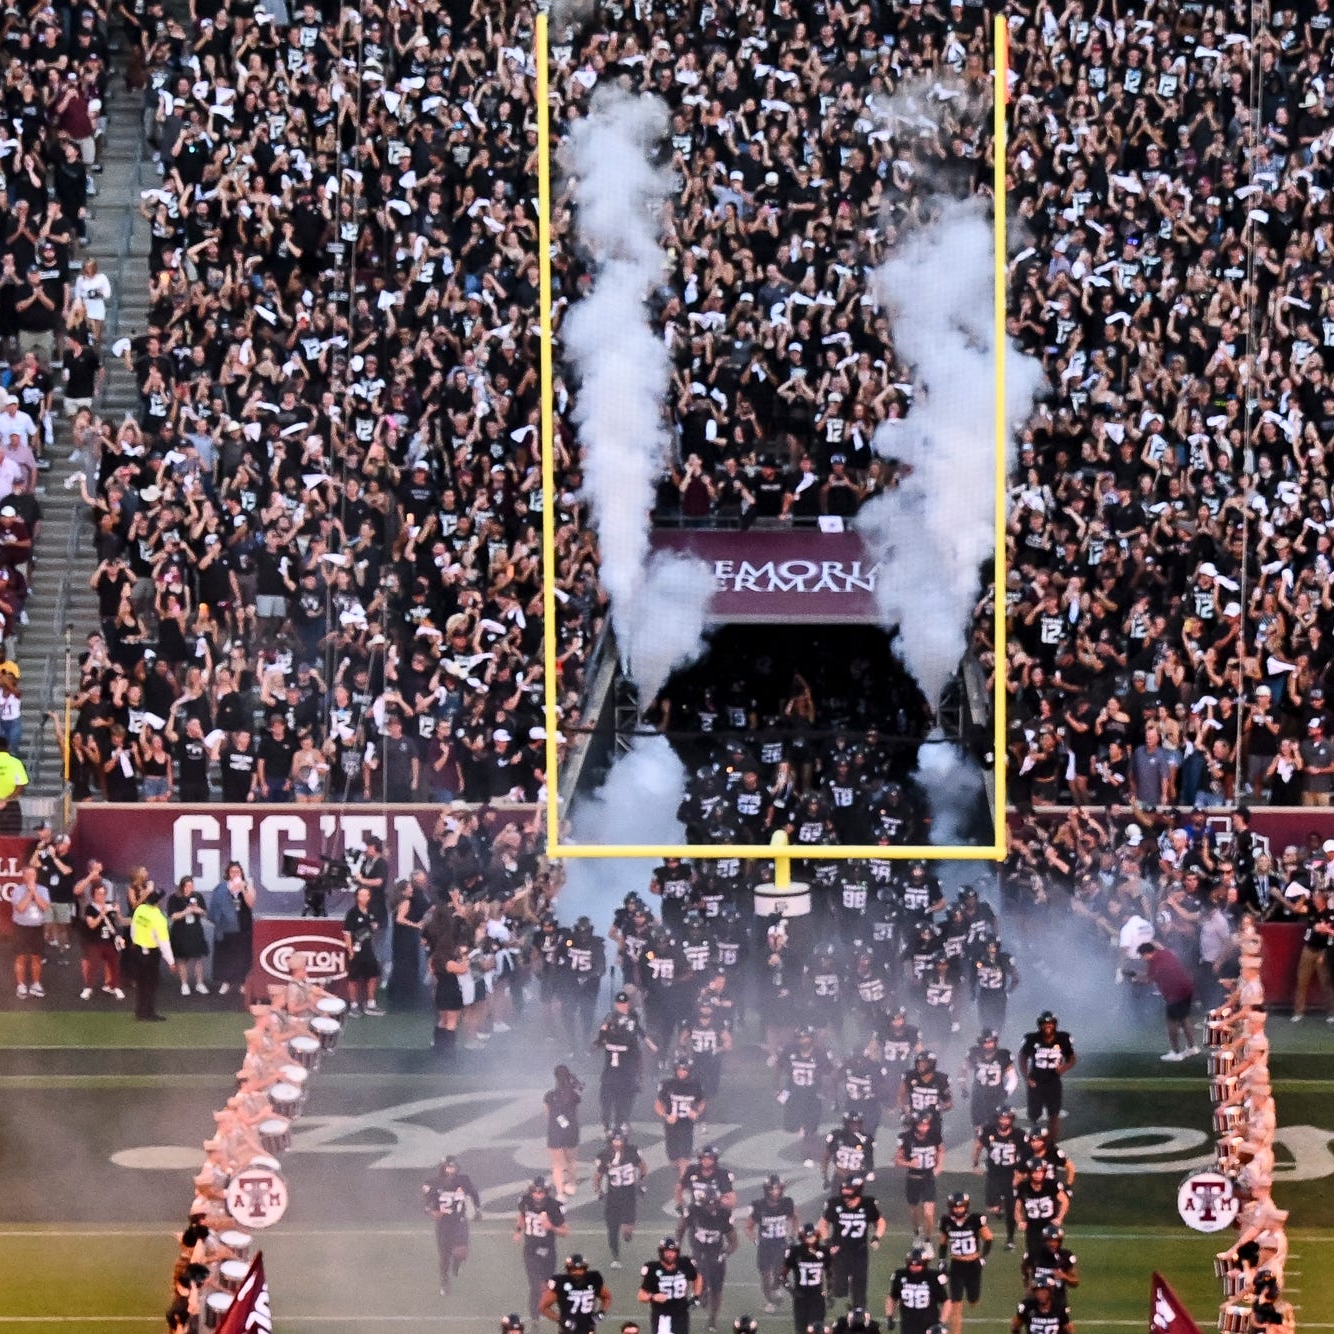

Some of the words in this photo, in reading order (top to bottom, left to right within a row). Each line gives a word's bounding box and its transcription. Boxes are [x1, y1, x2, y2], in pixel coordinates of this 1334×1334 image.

[989, 1149, 1016, 1166] 45
[839, 1221, 867, 1238] 73
[950, 1237, 977, 1256] 20
